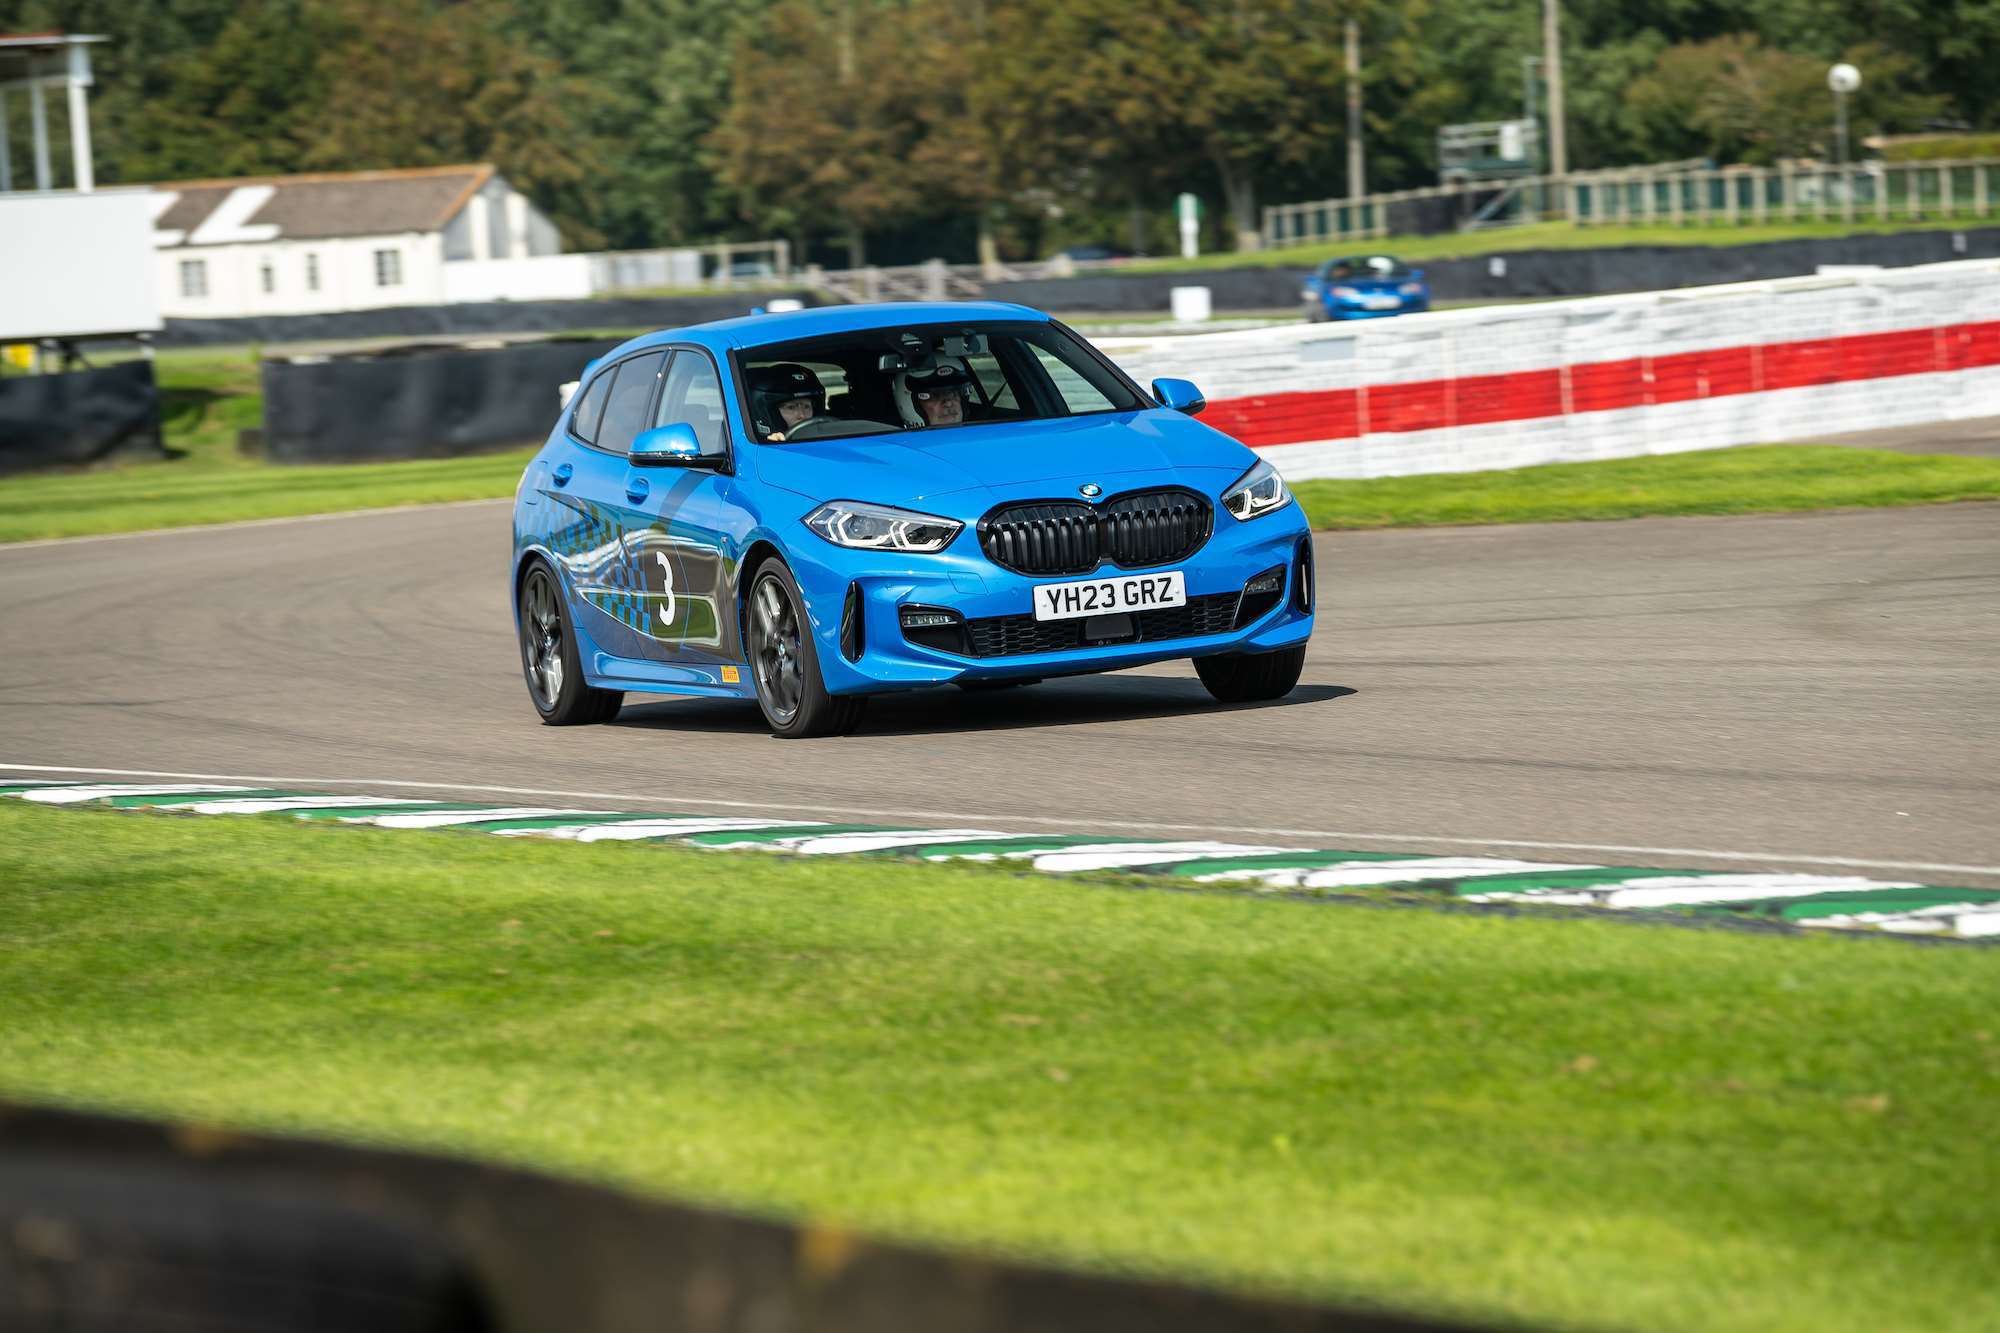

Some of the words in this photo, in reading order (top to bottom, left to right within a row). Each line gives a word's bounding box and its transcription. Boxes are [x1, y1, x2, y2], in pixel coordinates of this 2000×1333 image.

[656, 551, 675, 625] 3
[1046, 584, 1116, 614] YH23
[1123, 577, 1174, 606] GRZ
